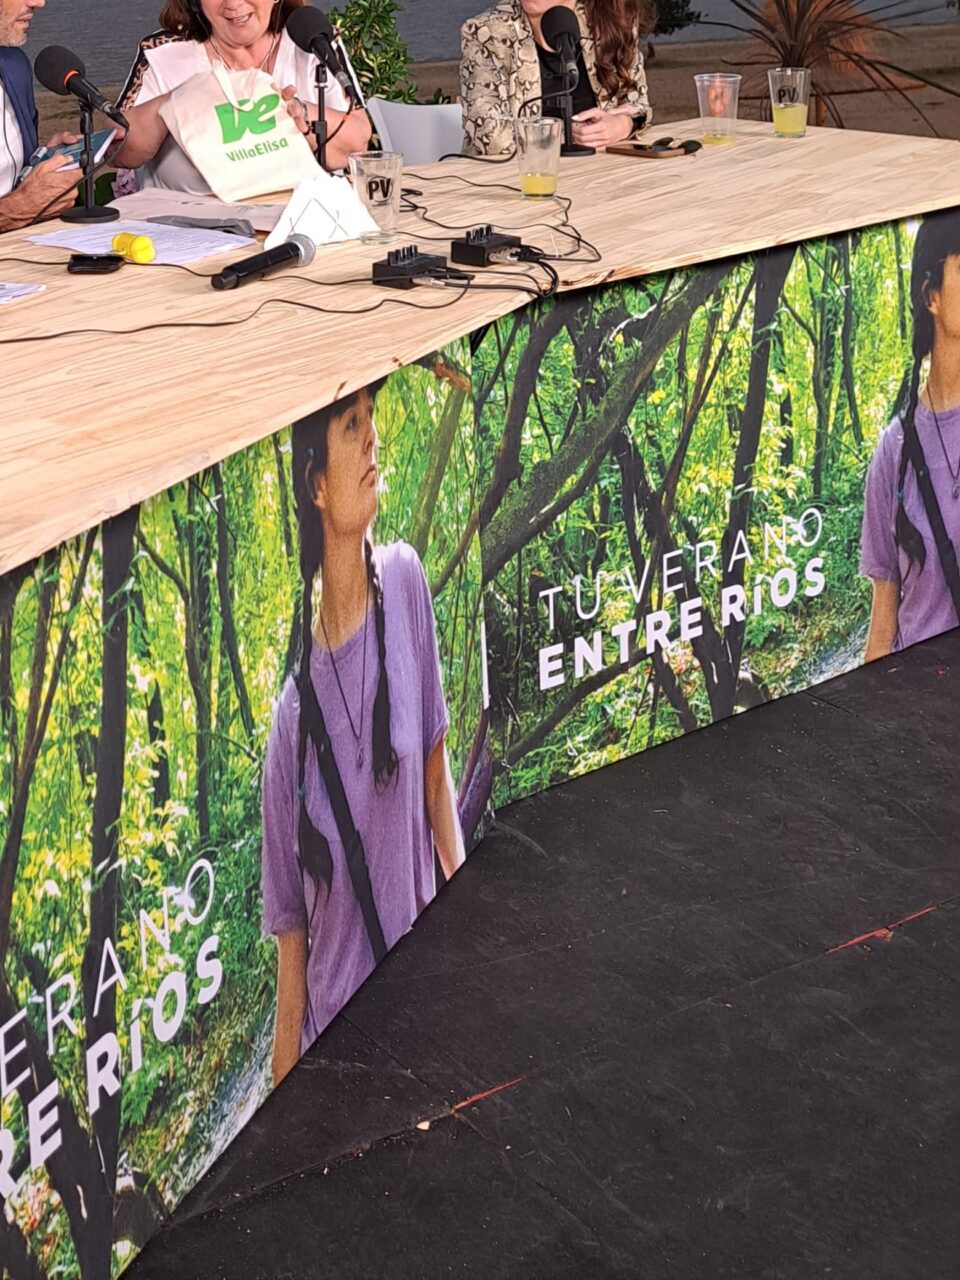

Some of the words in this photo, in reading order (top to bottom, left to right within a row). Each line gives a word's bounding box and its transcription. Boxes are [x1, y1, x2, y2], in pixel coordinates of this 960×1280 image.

[778, 87, 797, 104] PV
[225, 137, 289, 161] VillaElisa
[368, 177, 392, 200] PV
[539, 571, 601, 630] TU
[624, 507, 823, 604] VERANO
[539, 597, 704, 691] ENTRE
